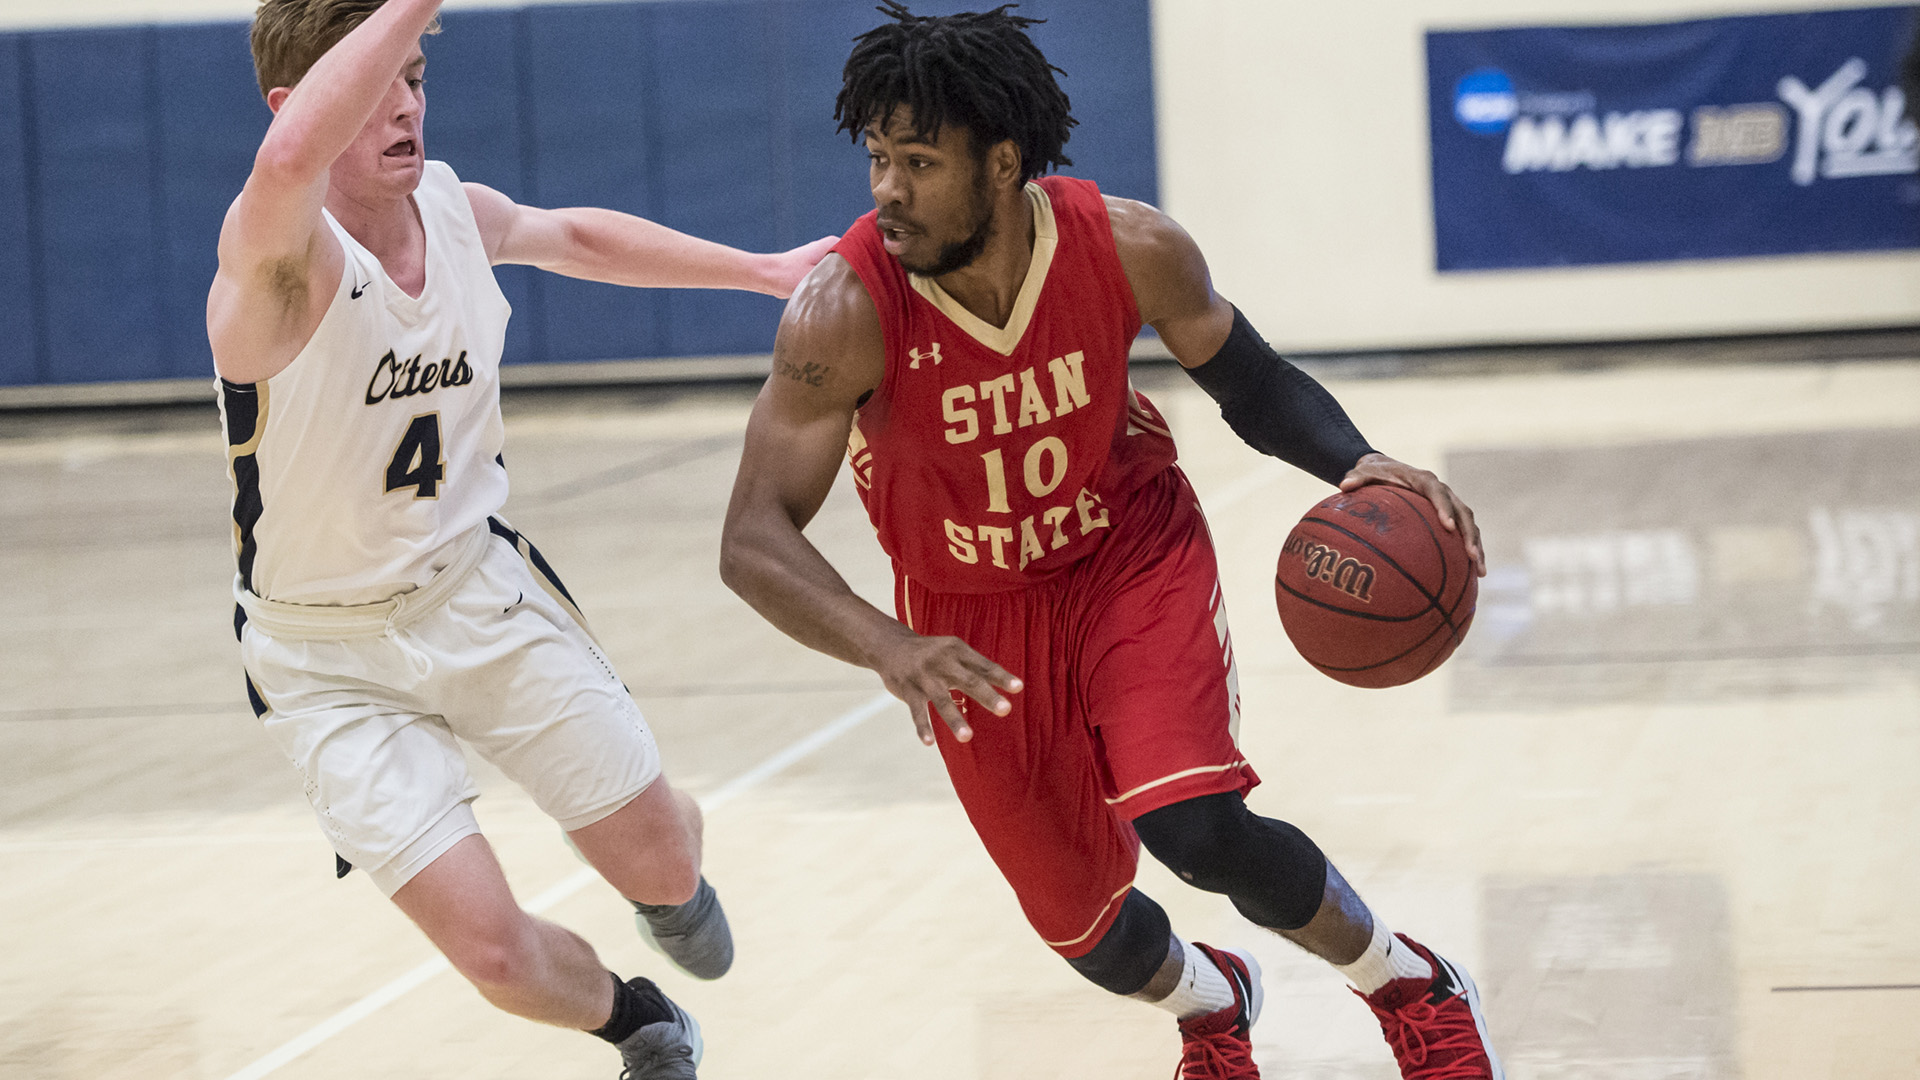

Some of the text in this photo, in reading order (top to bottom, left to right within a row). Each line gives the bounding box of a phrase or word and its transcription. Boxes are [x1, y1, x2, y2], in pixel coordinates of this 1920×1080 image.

[1502, 107, 1683, 174] MAKE
[365, 348, 473, 405] Otters
[942, 350, 1091, 445] STAN
[382, 410, 447, 500] 4
[981, 436, 1069, 514] 10
[943, 486, 1110, 572] STATE
